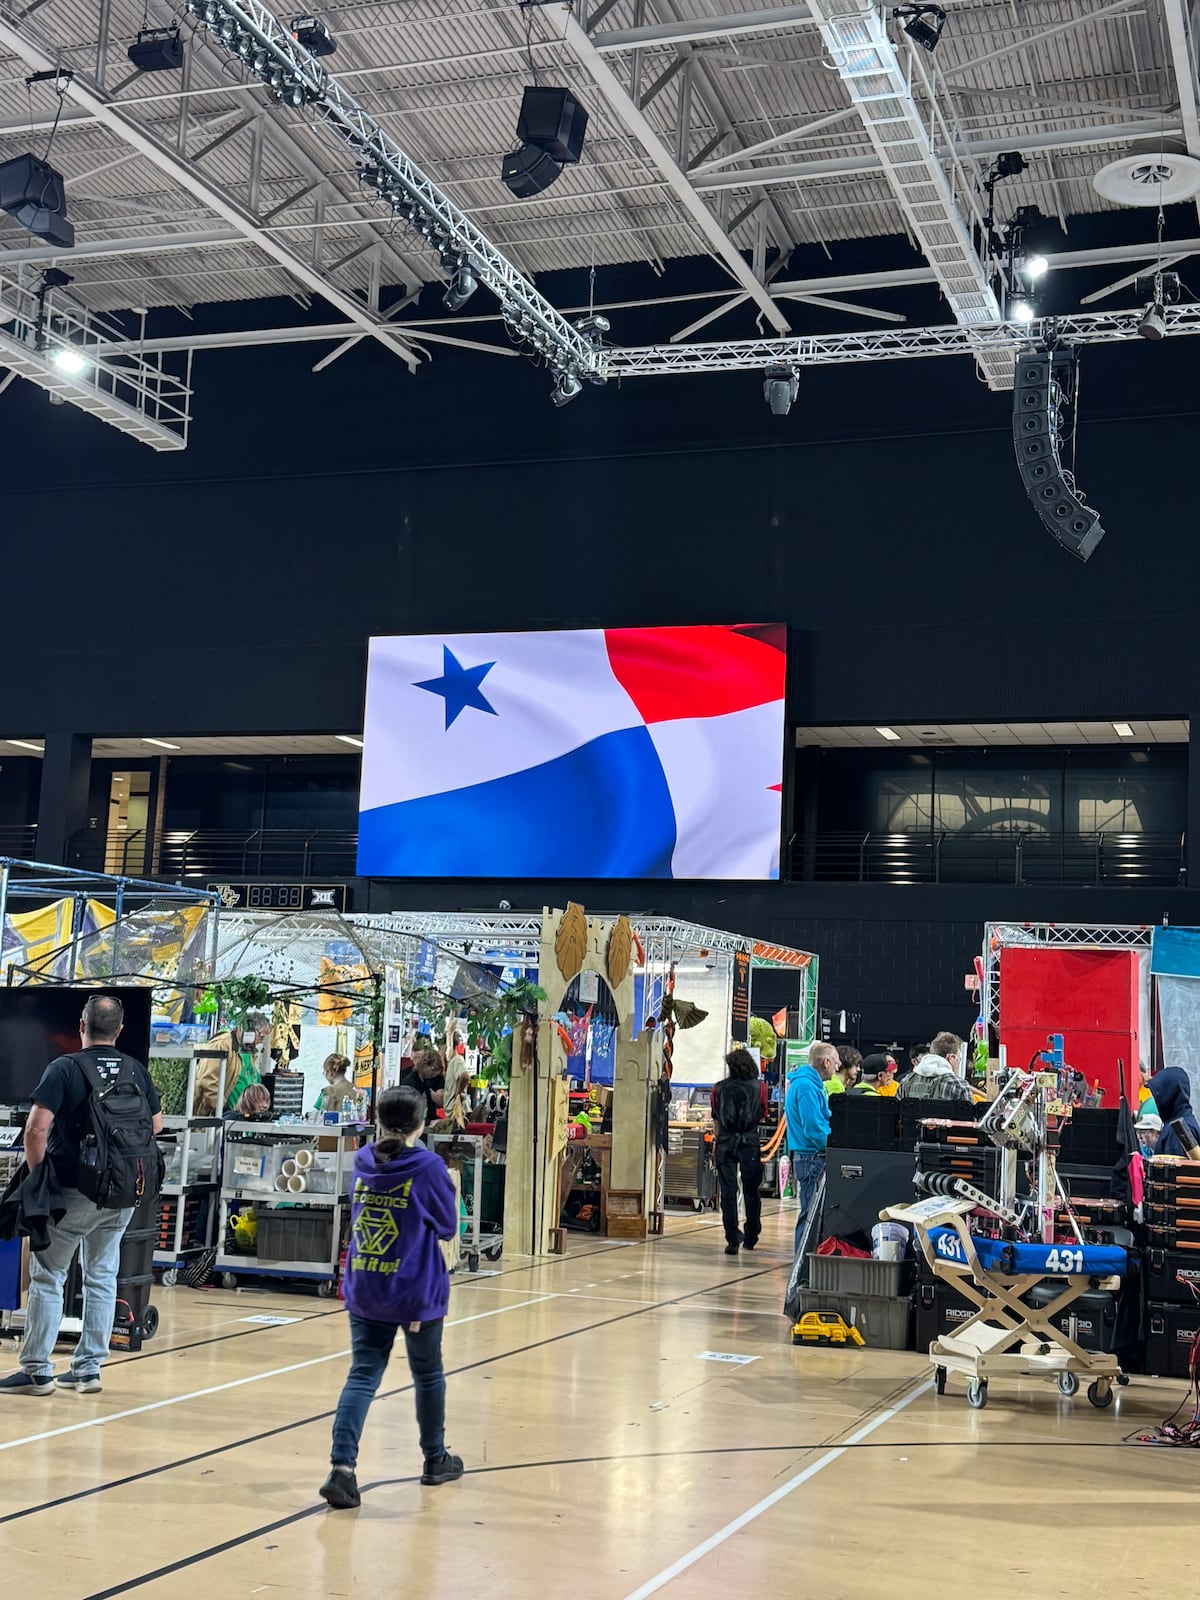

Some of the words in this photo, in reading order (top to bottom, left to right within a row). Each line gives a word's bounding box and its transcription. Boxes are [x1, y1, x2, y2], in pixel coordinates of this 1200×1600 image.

[216, 886, 240, 908] UCF
[353, 1193, 408, 1209] ROBOTICS
[938, 1233, 961, 1259] 431
[1045, 1249, 1084, 1273] 431
[945, 1308, 976, 1319] RIDGID
[1061, 1318, 1093, 1329] RGID
